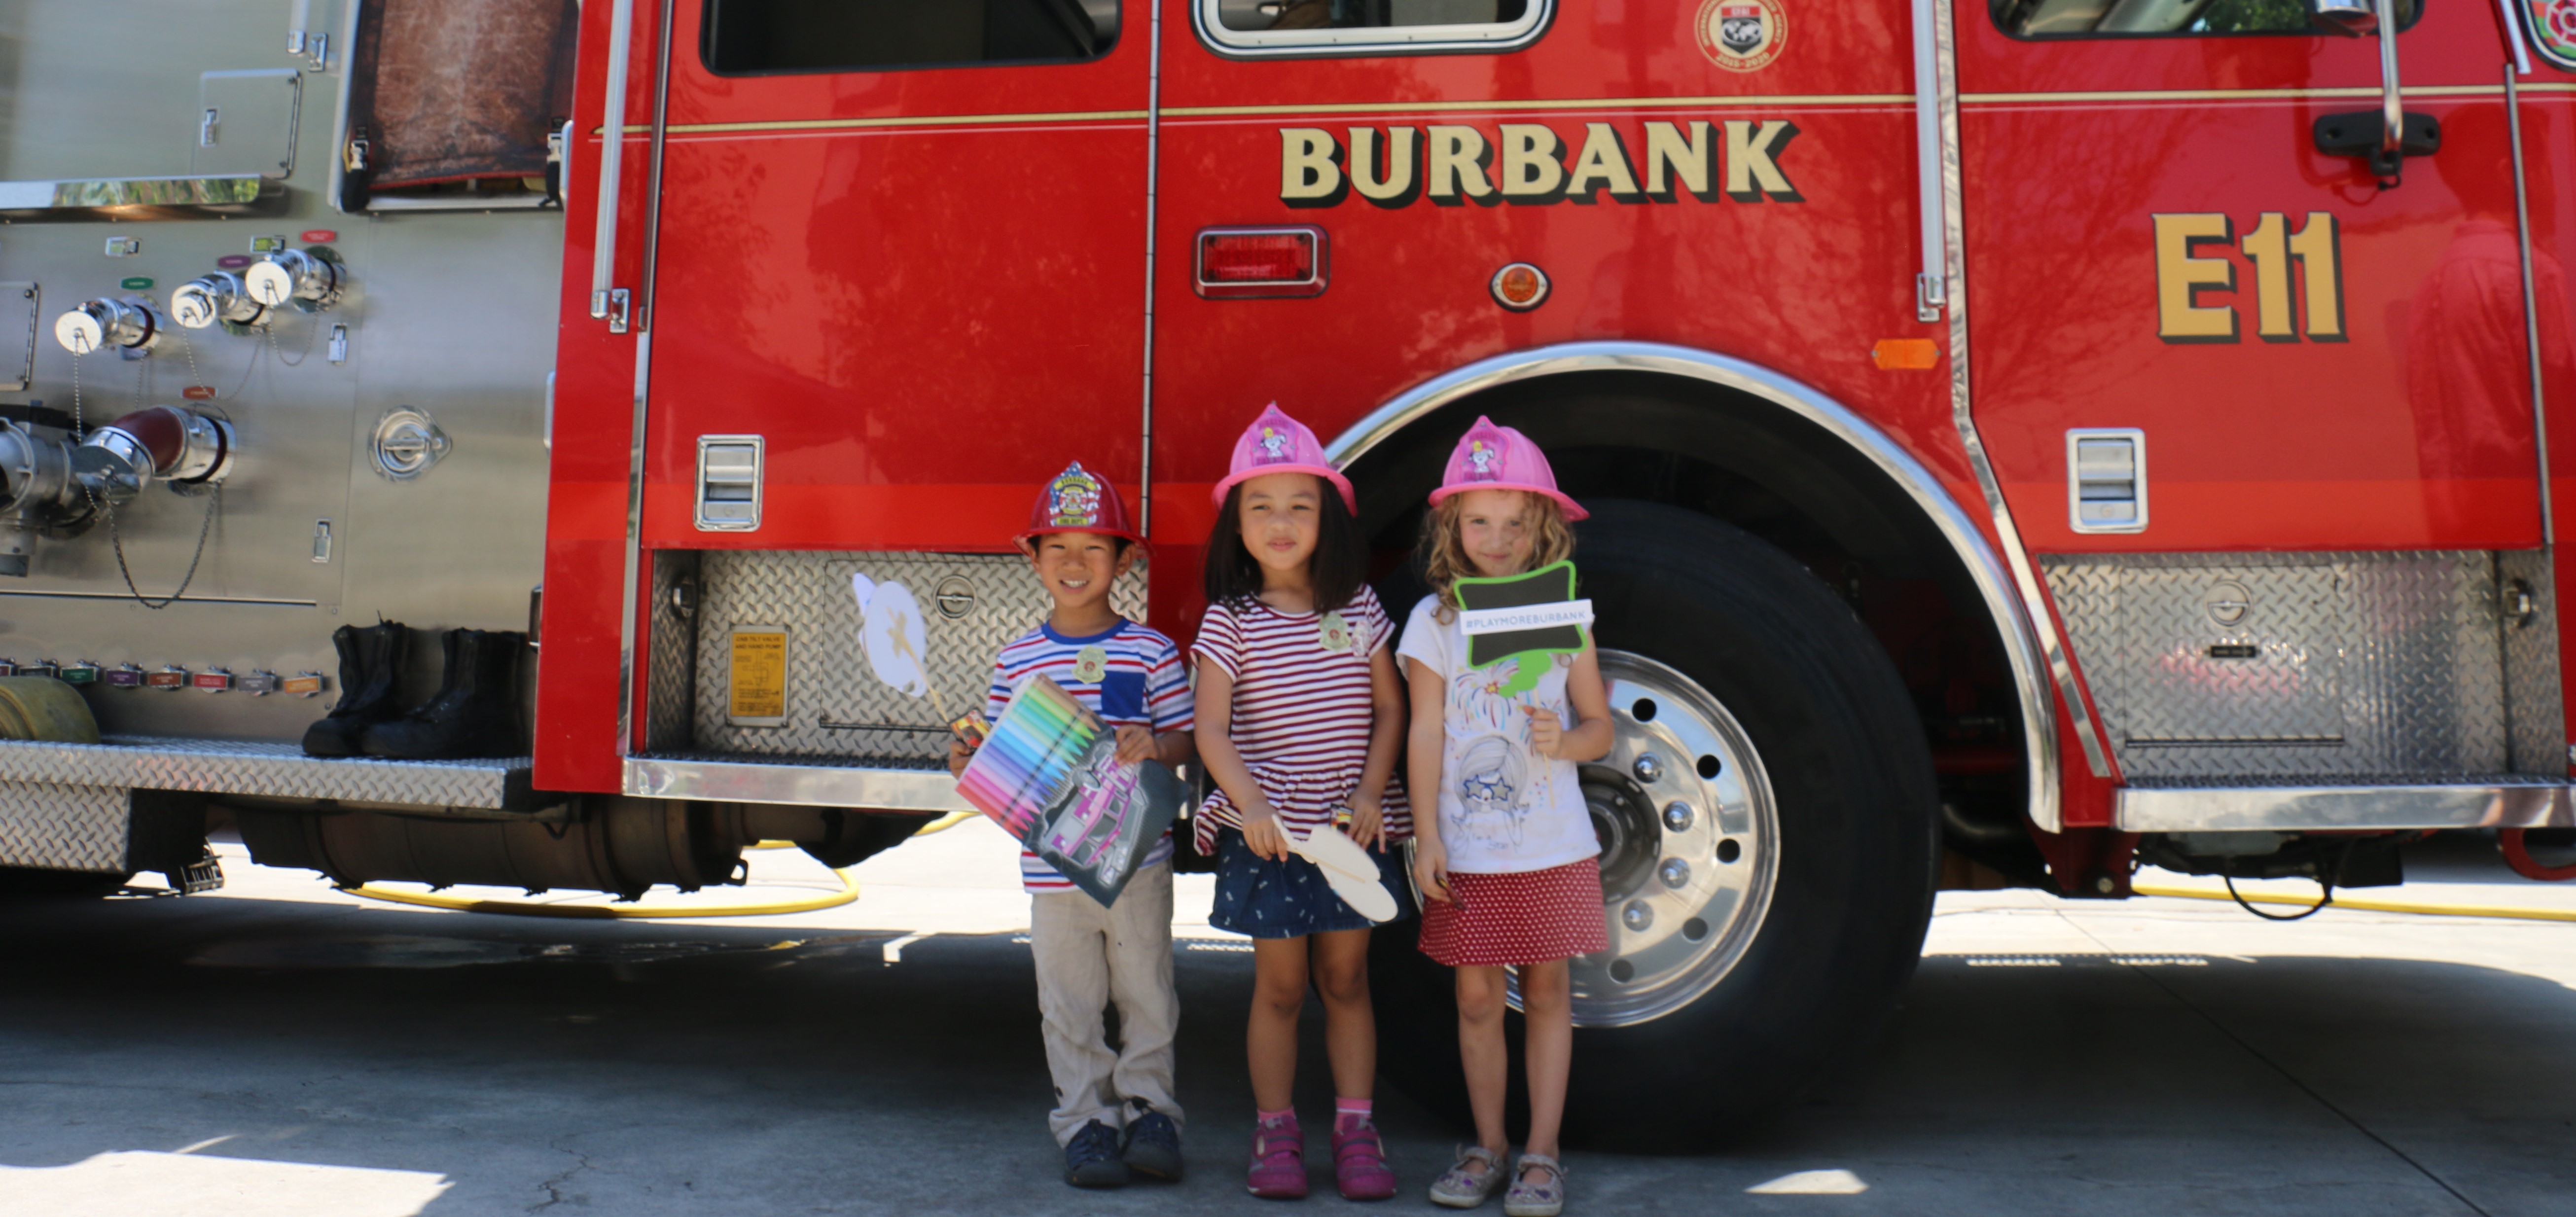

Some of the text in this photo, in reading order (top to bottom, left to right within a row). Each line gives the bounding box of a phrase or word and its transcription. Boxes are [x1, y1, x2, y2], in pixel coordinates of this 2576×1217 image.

[1279, 120, 1804, 208] BURBANK
[2151, 212, 2349, 343] E11
[1466, 611, 1585, 629] #PLAYMOREBURBANK
